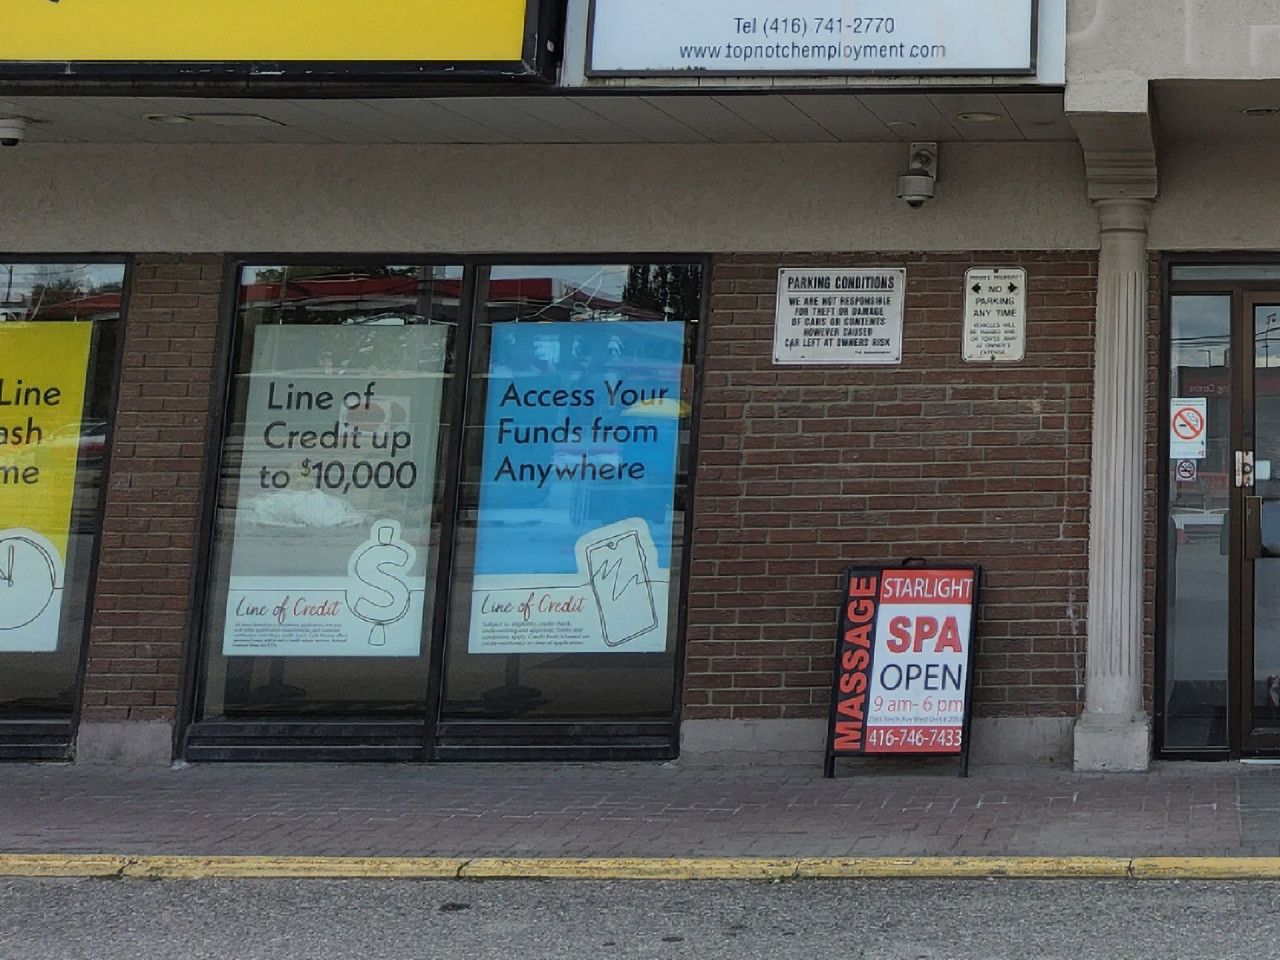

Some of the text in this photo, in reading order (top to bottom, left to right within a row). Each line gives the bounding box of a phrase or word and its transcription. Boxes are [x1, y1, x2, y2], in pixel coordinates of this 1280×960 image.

[734, 17, 895, 37] Tel (416) 741-2770
[788, 276, 895, 289] PARKING CONDITIONS
[789, 297, 891, 306] WE ARE NOT RESPONSIBLE
[975, 297, 1015, 305] PARKING
[795, 307, 884, 316] FOR THEFT OR DAMAGE
[973, 309, 1016, 317] ANY TIME
[791, 318, 886, 326] OF CARS OR CONTENTS
[784, 338, 799, 347] CAR
[803, 338, 820, 347] LEFT
[824, 338, 833, 347] AT
[872, 338, 890, 347] RISK
[803, 328, 873, 337] HOWEVER CAUSED
[268, 381, 375, 410] Line of
[499, 380, 669, 407] Access Your
[264, 420, 411, 457] Credit up
[497, 417, 658, 444] Funds from
[260, 457, 417, 494] to $10,000
[494, 453, 645, 488] Anywhere
[883, 578, 973, 598] STARLIGHT
[236, 596, 341, 624] Line of Credit
[482, 592, 584, 621] Line of Credit
[886, 616, 963, 653] SPA
[834, 576, 877, 750] MASSAGE
[880, 664, 962, 691] OPEN
[874, 696, 883, 712] 9
[923, 696, 932, 712] 6
[937, 699, 963, 716] pm
[869, 729, 962, 746] 416-746-7433
